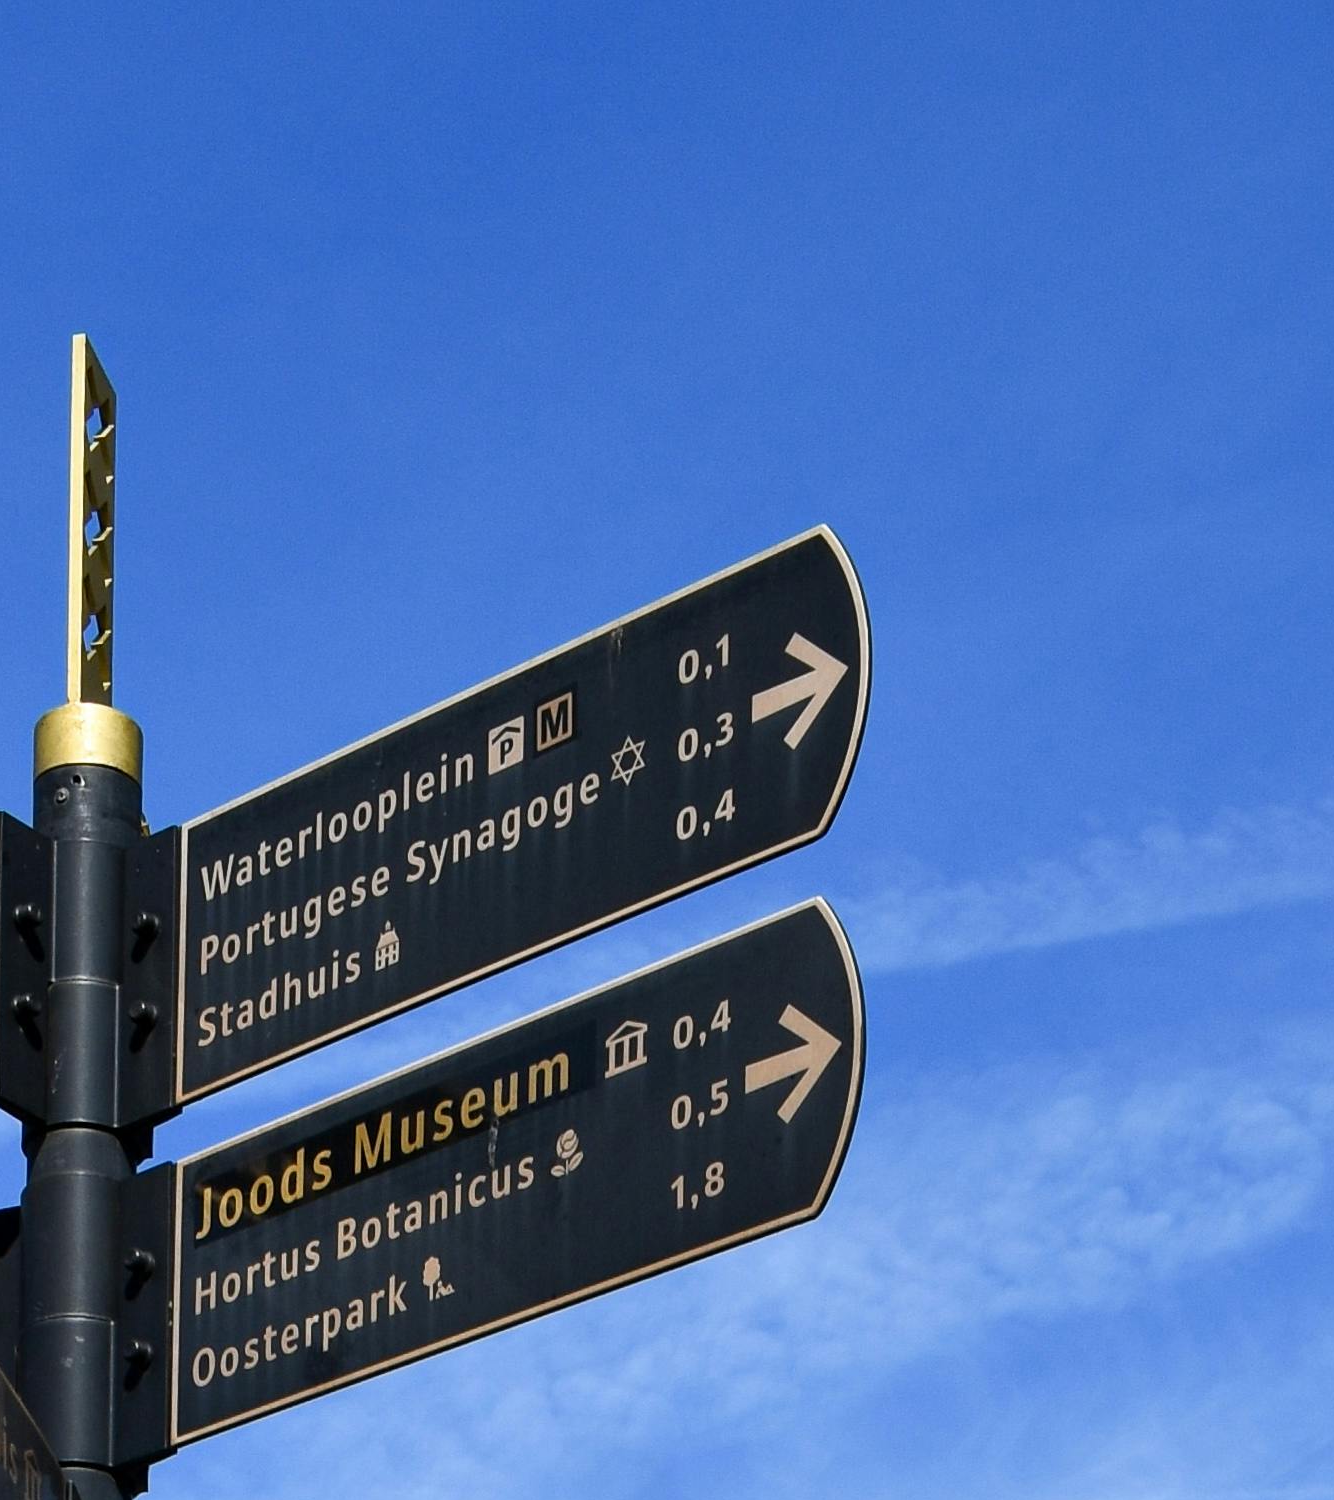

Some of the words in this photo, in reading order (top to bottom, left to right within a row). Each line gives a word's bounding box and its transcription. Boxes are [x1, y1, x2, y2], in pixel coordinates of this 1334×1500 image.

[199, 861, 391, 974] Portugese
[406, 770, 601, 885] Synagoge
[677, 711, 734, 762] 0,3
[200, 750, 474, 901] Waterlooplein
[678, 634, 731, 685] 0,1
[198, 947, 361, 1047] Stadhuis
[676, 788, 736, 841] 0,4
[193, 1235, 321, 1316] Hortus
[337, 1154, 535, 1261] Botanicus
[671, 1080, 729, 1131] 0,5
[195, 1147, 332, 1241] Joods
[353, 1049, 570, 1175] Museum
[672, 1001, 731, 1050] 0,4
[191, 1274, 407, 1388] Oosterpark
[671, 1161, 725, 1211] 1,8
